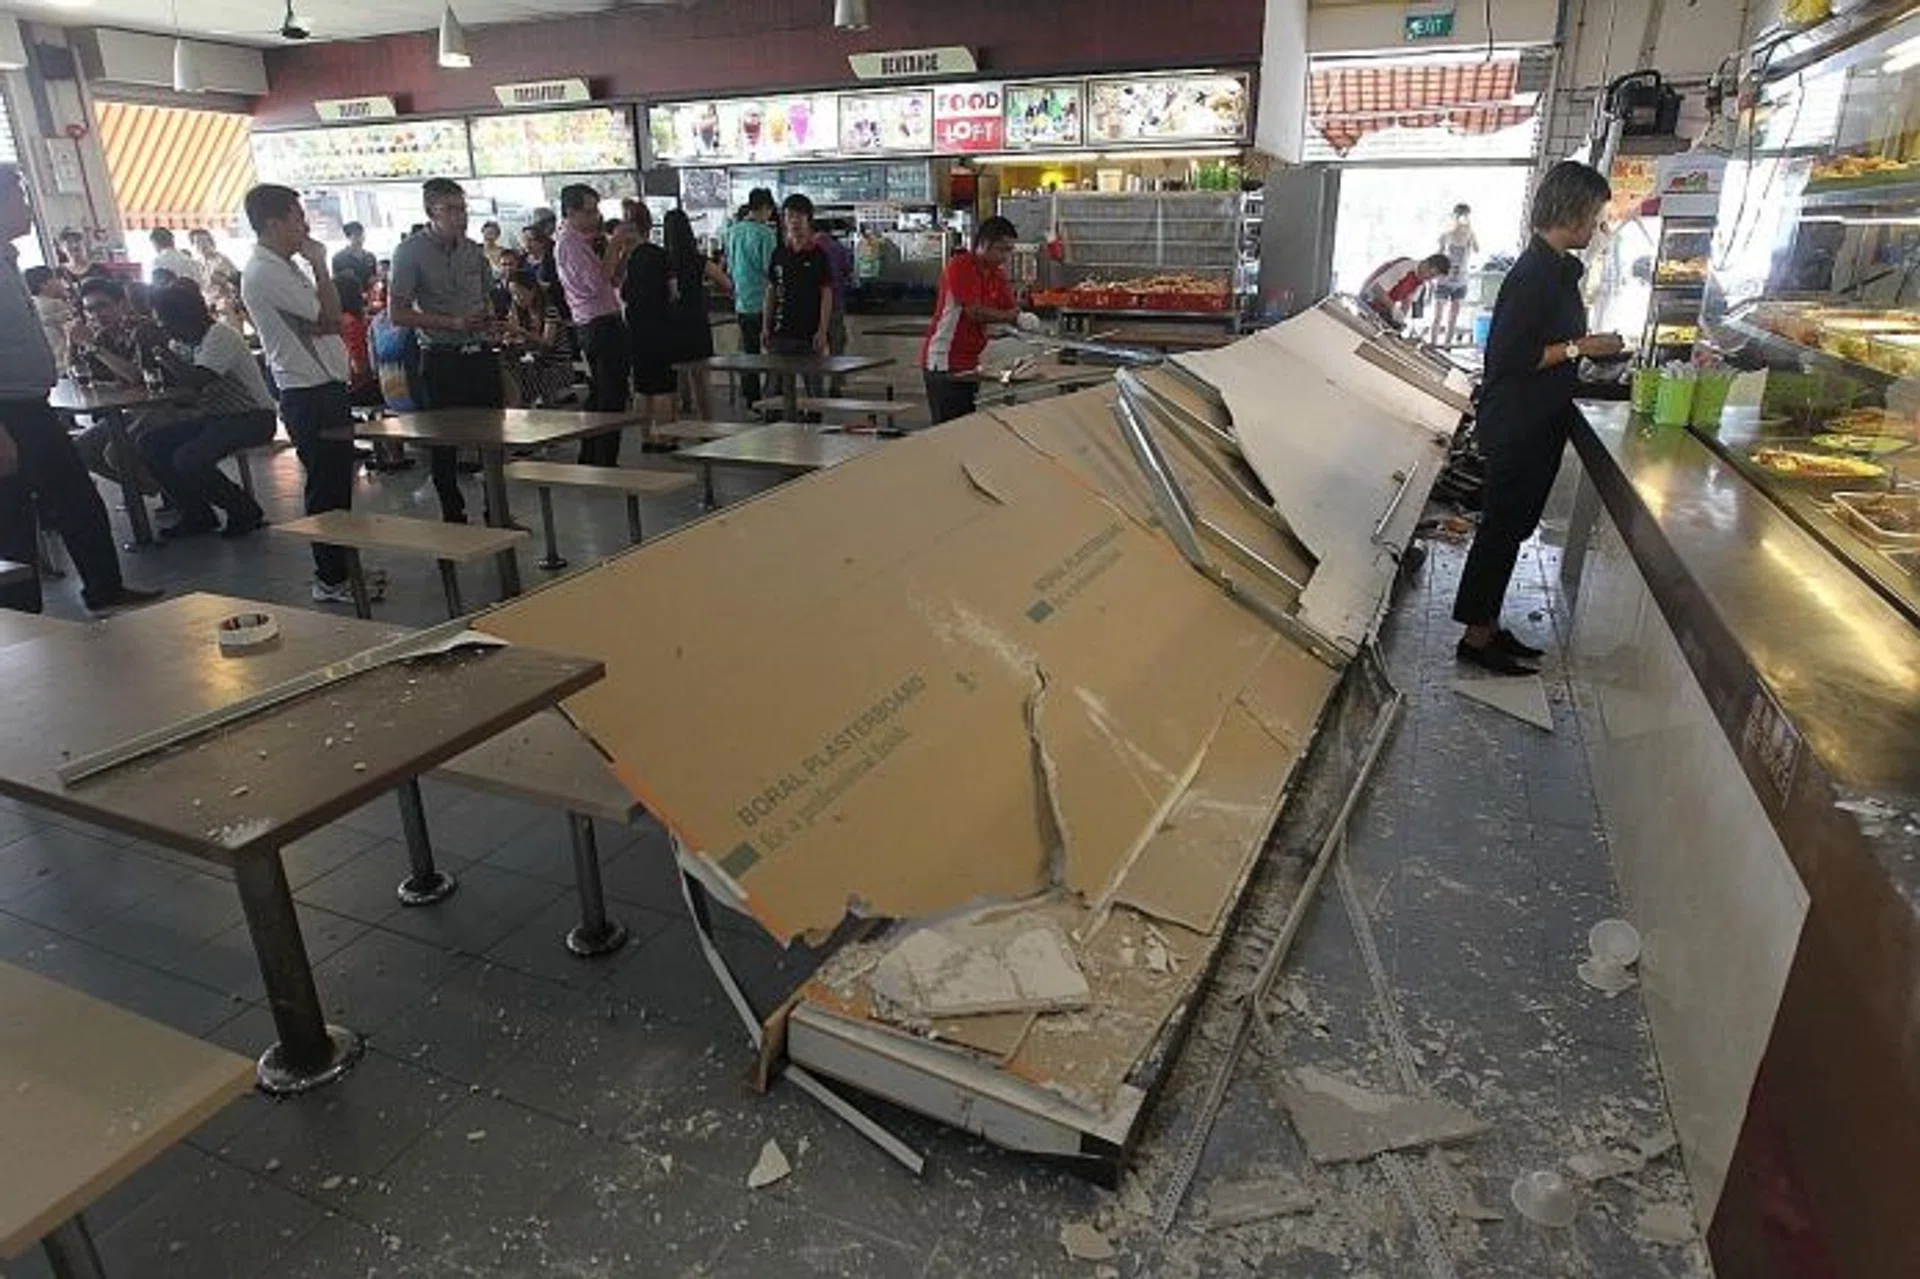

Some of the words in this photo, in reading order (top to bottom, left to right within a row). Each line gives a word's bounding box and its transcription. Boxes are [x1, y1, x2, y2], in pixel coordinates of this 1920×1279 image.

[939, 92, 999, 110] FOOD
[945, 121, 995, 142] LOFT
[737, 772, 808, 828] BORAL
[801, 674, 927, 776] PLASTERBOARD
